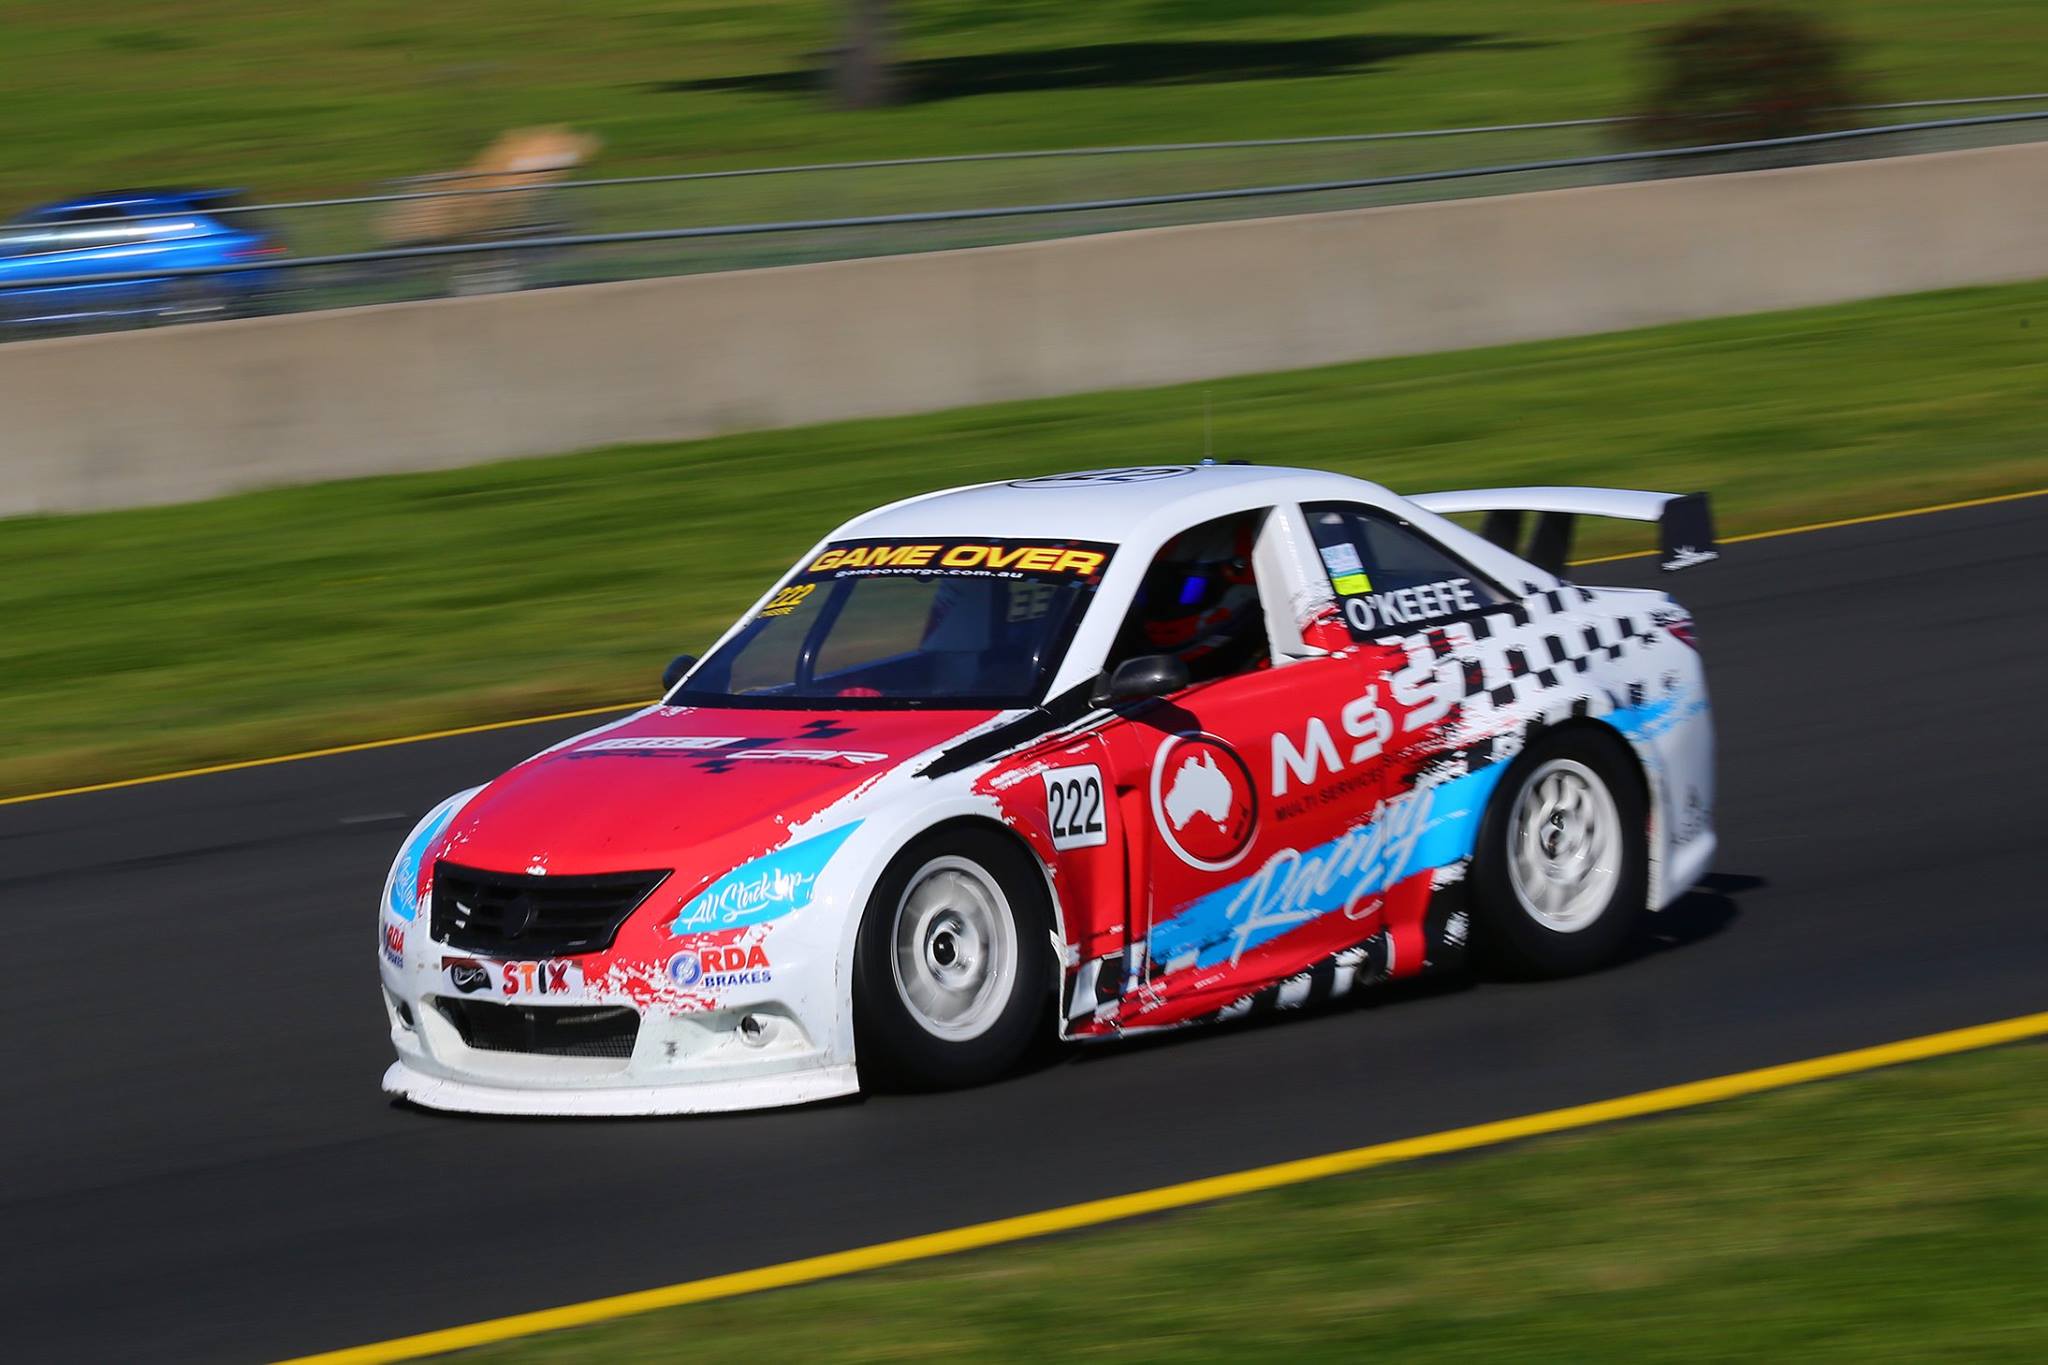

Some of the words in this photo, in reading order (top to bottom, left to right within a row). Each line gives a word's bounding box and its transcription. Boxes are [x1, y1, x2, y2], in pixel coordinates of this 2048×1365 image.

[808, 545, 944, 572] GAME
[940, 545, 1105, 575] OVER
[834, 568, 1024, 579] gameovergc.com.au
[1345, 577, 1480, 632] O'KEEFE
[726, 749, 888, 764] CAR
[1050, 776, 1103, 838] 222
[681, 893, 719, 930] All
[719, 873, 775, 923] Stuck
[700, 945, 770, 973] RDA
[502, 962, 570, 996] STIX
[705, 970, 771, 987] BRAKES
